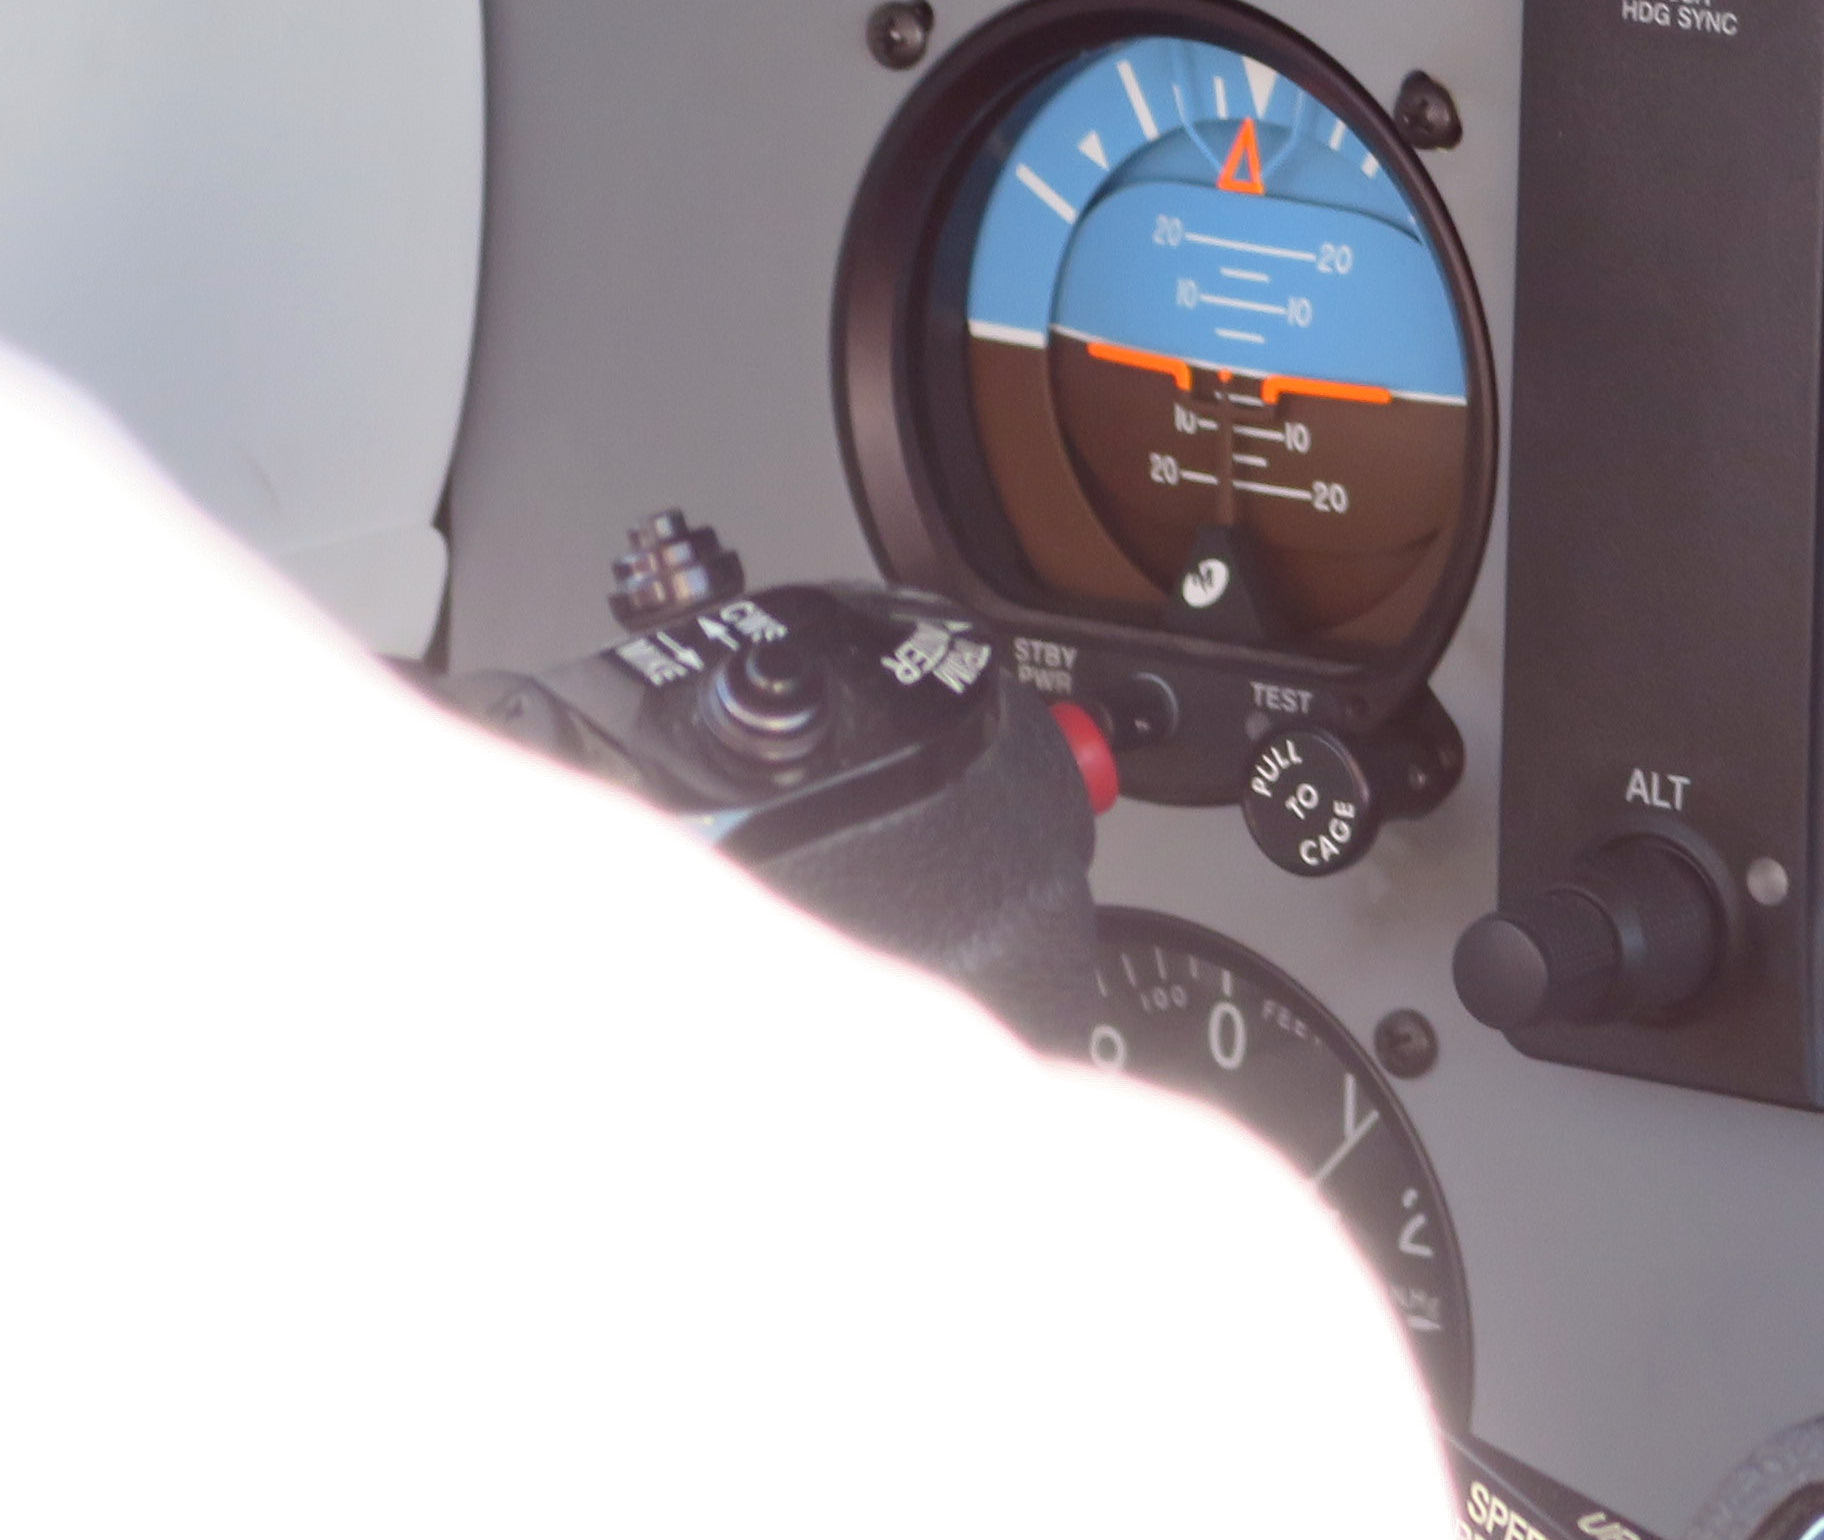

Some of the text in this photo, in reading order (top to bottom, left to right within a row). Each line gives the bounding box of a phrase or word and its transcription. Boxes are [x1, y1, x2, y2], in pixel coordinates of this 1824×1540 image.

[1678, 6, 1738, 36] SYNC
[1250, 682, 1312, 713] TEST
[1253, 740, 1302, 798] PULL
[1287, 784, 1318, 820] TO
[1626, 769, 1690, 812] ALT
[1301, 801, 1355, 865] CAGE
